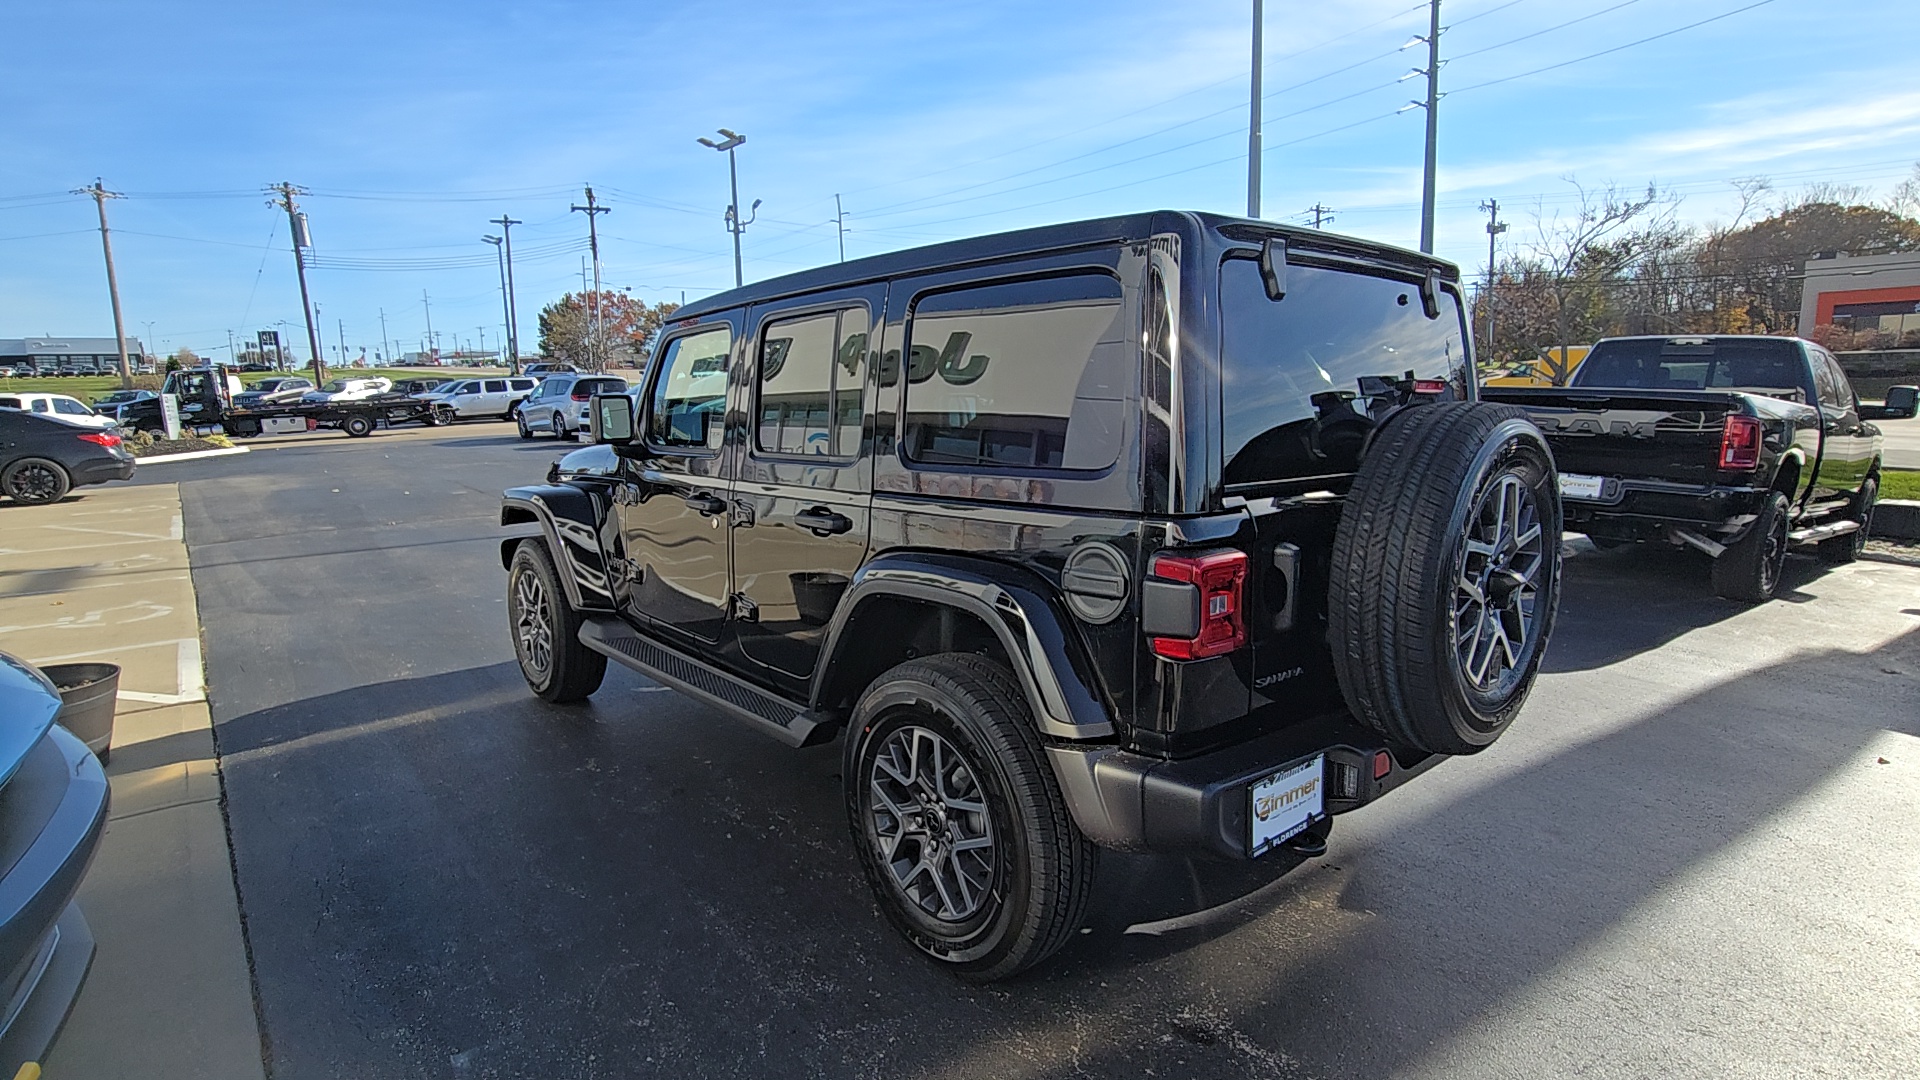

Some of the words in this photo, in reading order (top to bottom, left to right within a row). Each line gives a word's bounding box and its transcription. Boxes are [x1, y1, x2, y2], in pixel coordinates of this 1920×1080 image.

[1533, 417, 1656, 438] RAM
[1255, 666, 1304, 688] SAHARA
[1256, 776, 1320, 820] Zimmer
[1272, 821, 1308, 848] FLORENCE
